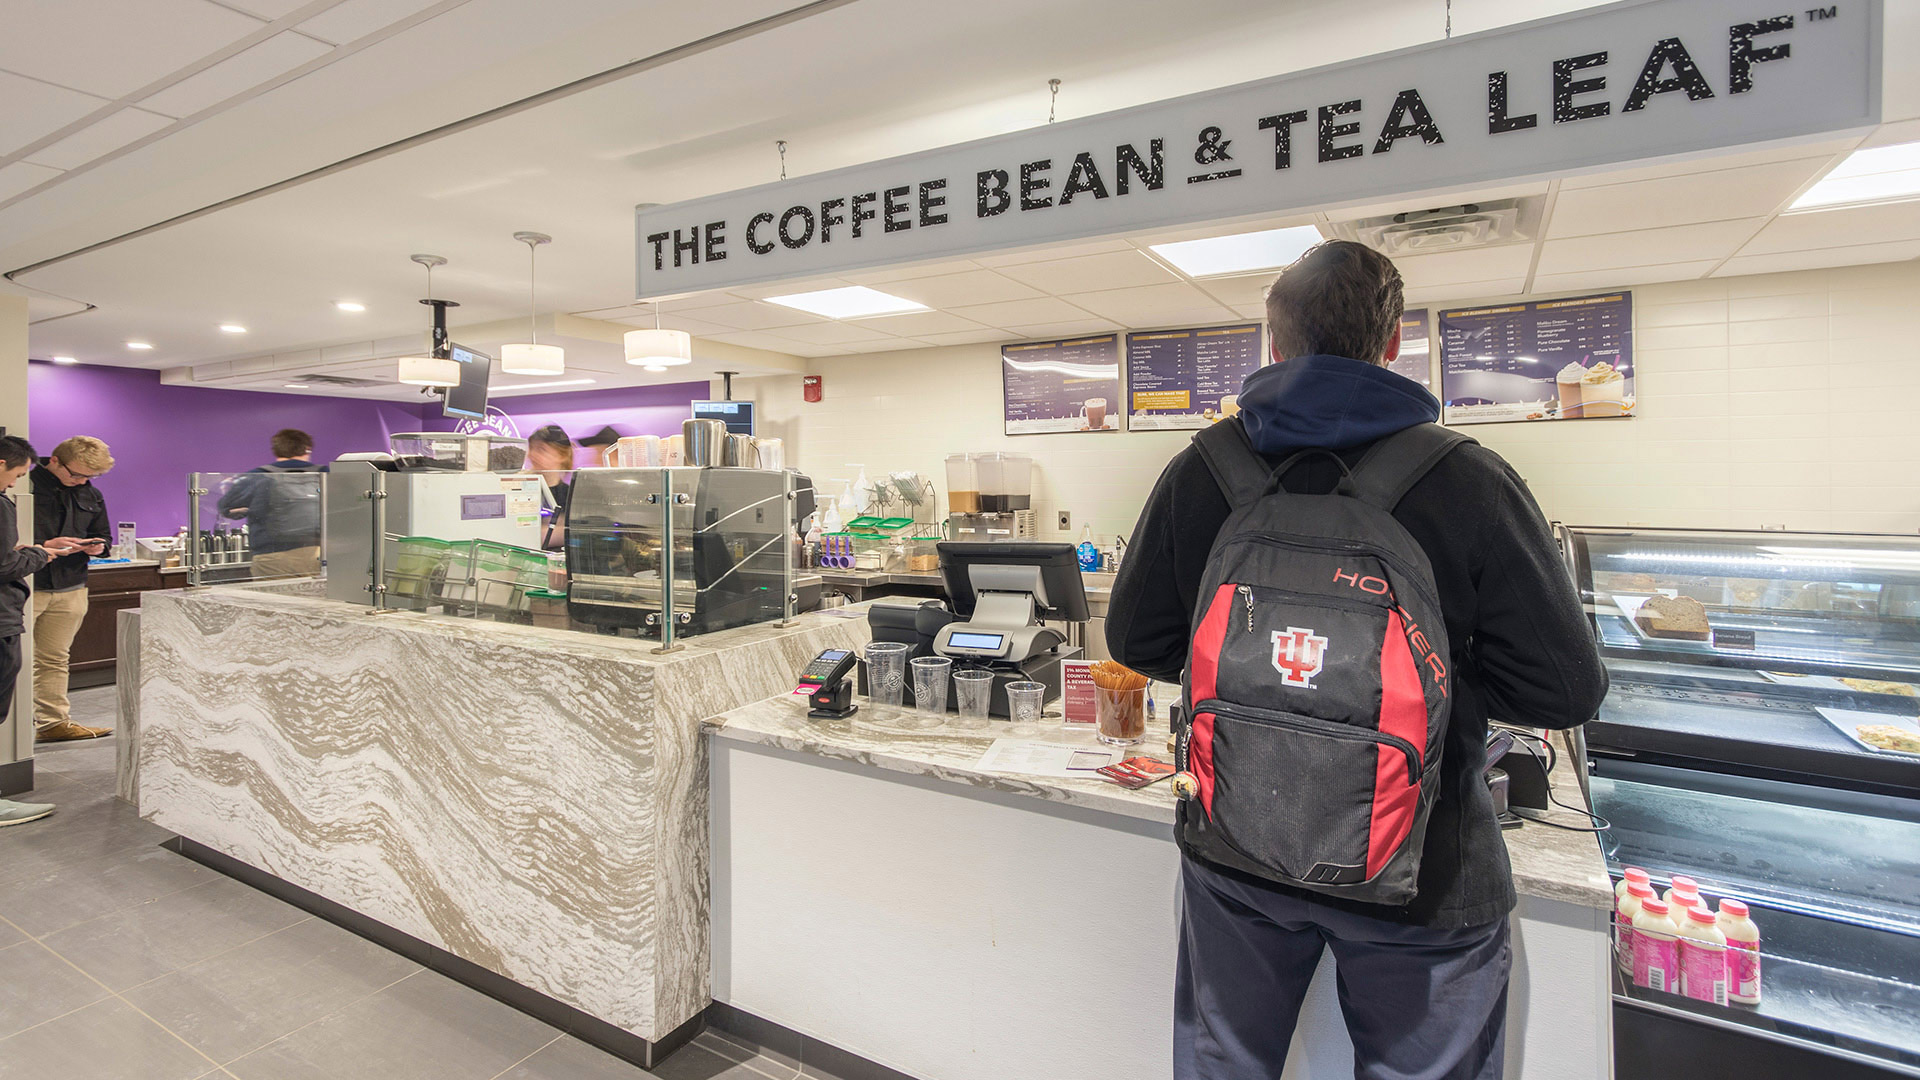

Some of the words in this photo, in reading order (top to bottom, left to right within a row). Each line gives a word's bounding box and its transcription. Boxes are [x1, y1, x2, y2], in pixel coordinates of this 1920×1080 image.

[647, 220, 728, 271] THE
[745, 178, 949, 256] COFFEE
[977, 137, 1164, 218] BEAN
[1193, 125, 1235, 167] &
[1258, 88, 1446, 171] TEA
[1488, 15, 1795, 137] LEAF
